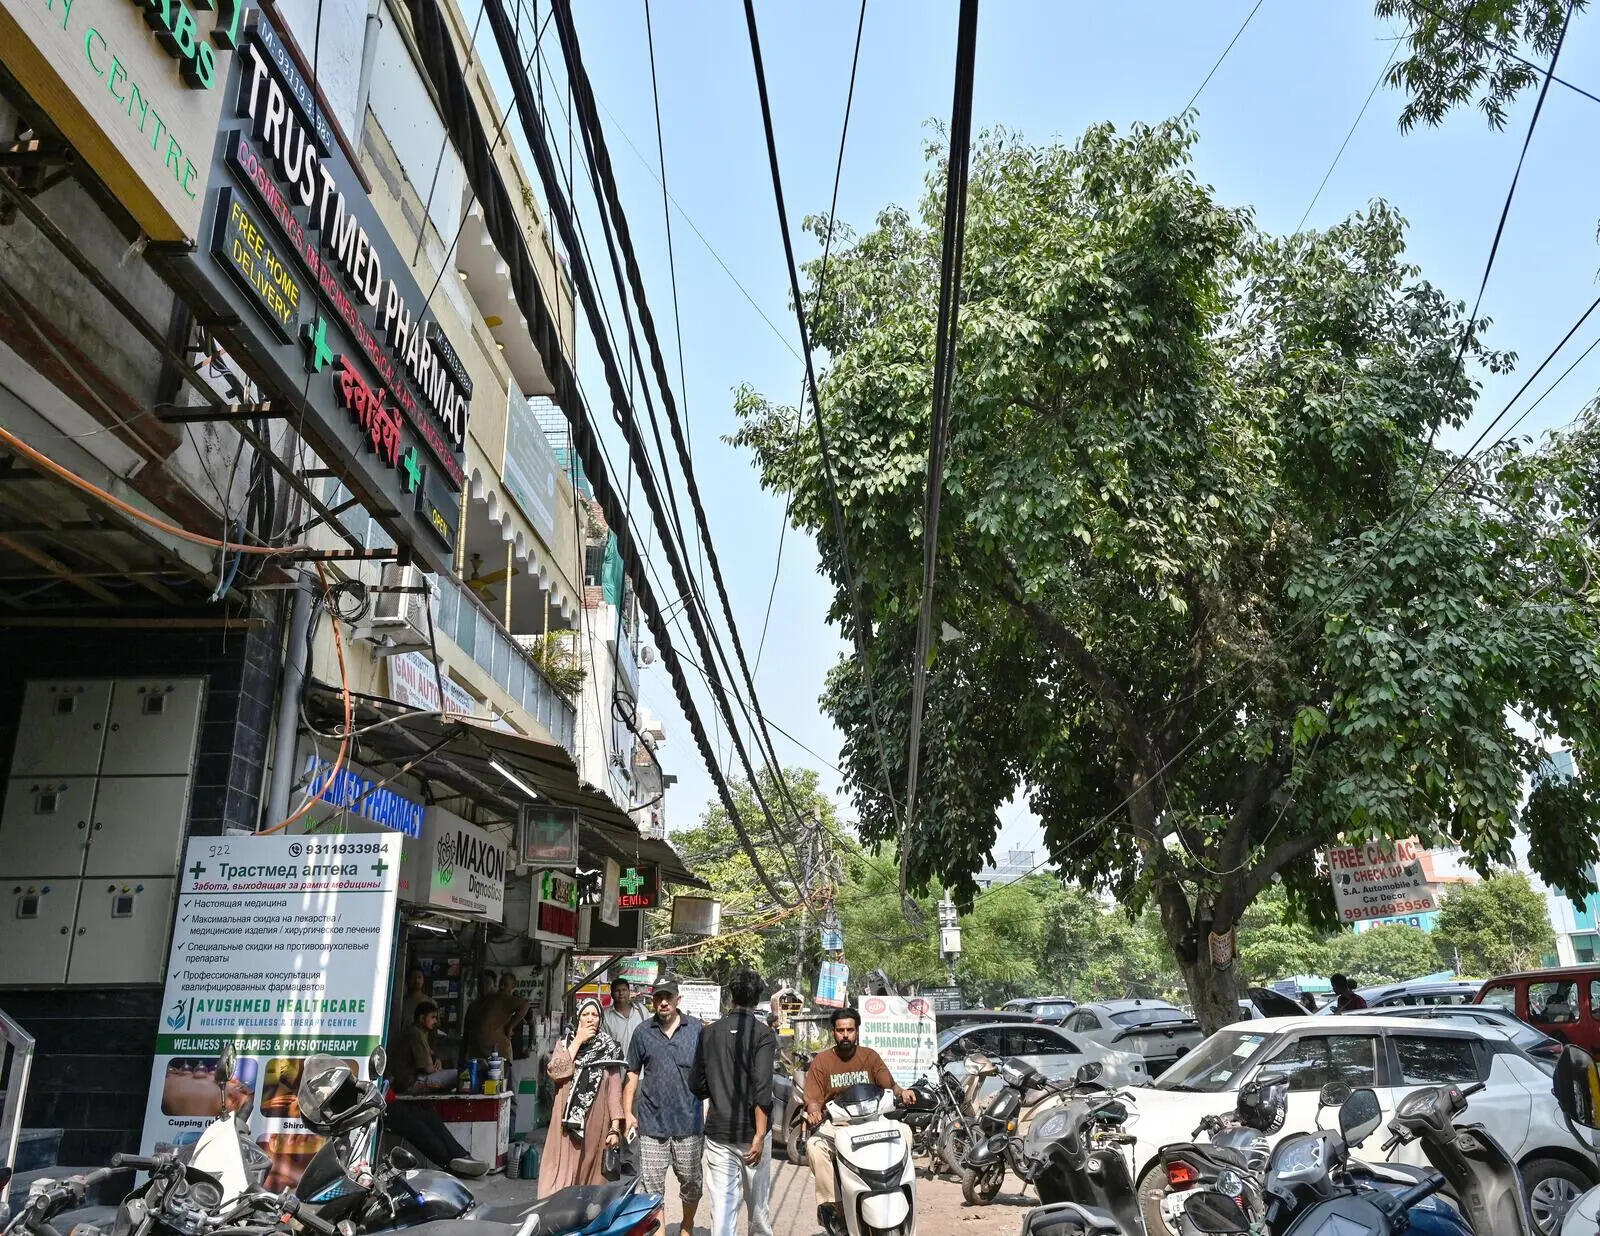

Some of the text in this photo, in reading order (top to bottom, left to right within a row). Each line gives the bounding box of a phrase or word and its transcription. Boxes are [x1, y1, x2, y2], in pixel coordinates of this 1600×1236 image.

[278, 49, 305, 102] 93119
[85, 28, 198, 200] CENTRE
[240, 141, 304, 249] COSMETICS
[305, 244, 357, 327] MEDICINES
[231, 202, 299, 307] FREE HOME
[233, 239, 291, 324] DELIVERY
[385, 279, 470, 447] PHARMACY
[432, 508, 448, 537] OPEN
[395, 656, 416, 689] GANI
[362, 780, 425, 839] PHARMACY
[209, 844, 232, 858] 922
[306, 843, 389, 855] 9311933984
[1330, 849, 1365, 869] FREE
[1397, 842, 1416, 861] AC
[455, 831, 504, 882] MAXON
[219, 862, 358, 880] Трастмед аптека
[1353, 865, 1402, 883] CHECK UP
[192, 881, 381, 891] Забота, выходящая за рамки медицины
[468, 874, 502, 902] Dignostics
[1343, 879, 1420, 896] S.A. Automobile &
[194, 899, 287, 909] Настоящая медицина
[1363, 892, 1406, 904] Car Decor
[1344, 899, 1431, 919] 9910495956
[191, 914, 251, 924] Максимальная
[253, 915, 280, 924] скидка
[282, 915, 292, 923] на
[294, 915, 336, 924] лекарства
[190, 926, 243, 936] медицинские
[245, 926, 278, 936] изделия
[284, 926, 344, 936] хирургическое
[345, 925, 381, 934] лечение
[187, 942, 243, 951] Специальные
[245, 943, 273, 952] скидки
[286, 943, 369, 952] противоопухолевые
[185, 955, 229, 963] препараты
[183, 971, 321, 981] Профессиональная консультация
[181, 982, 325, 992] квалифицированных фармацевтов
[196, 999, 366, 1013] AYUSHMED HEALTHCARE
[200, 1018, 235, 1027] HOLISTIC
[238, 1018, 278, 1027] WELLNESS
[289, 1018, 325, 1027] THERAPY
[327, 1018, 357, 1027] CENTRE
[864, 1021, 931, 1034] SHREE NARAYAN
[174, 1038, 220, 1050] WELLNESS
[274, 1039, 281, 1050] &
[282, 1039, 359, 1051] PHYSIOTHERAPY
[874, 1036, 921, 1048] PHARMACY
[168, 1118, 203, 1128] Cupping
